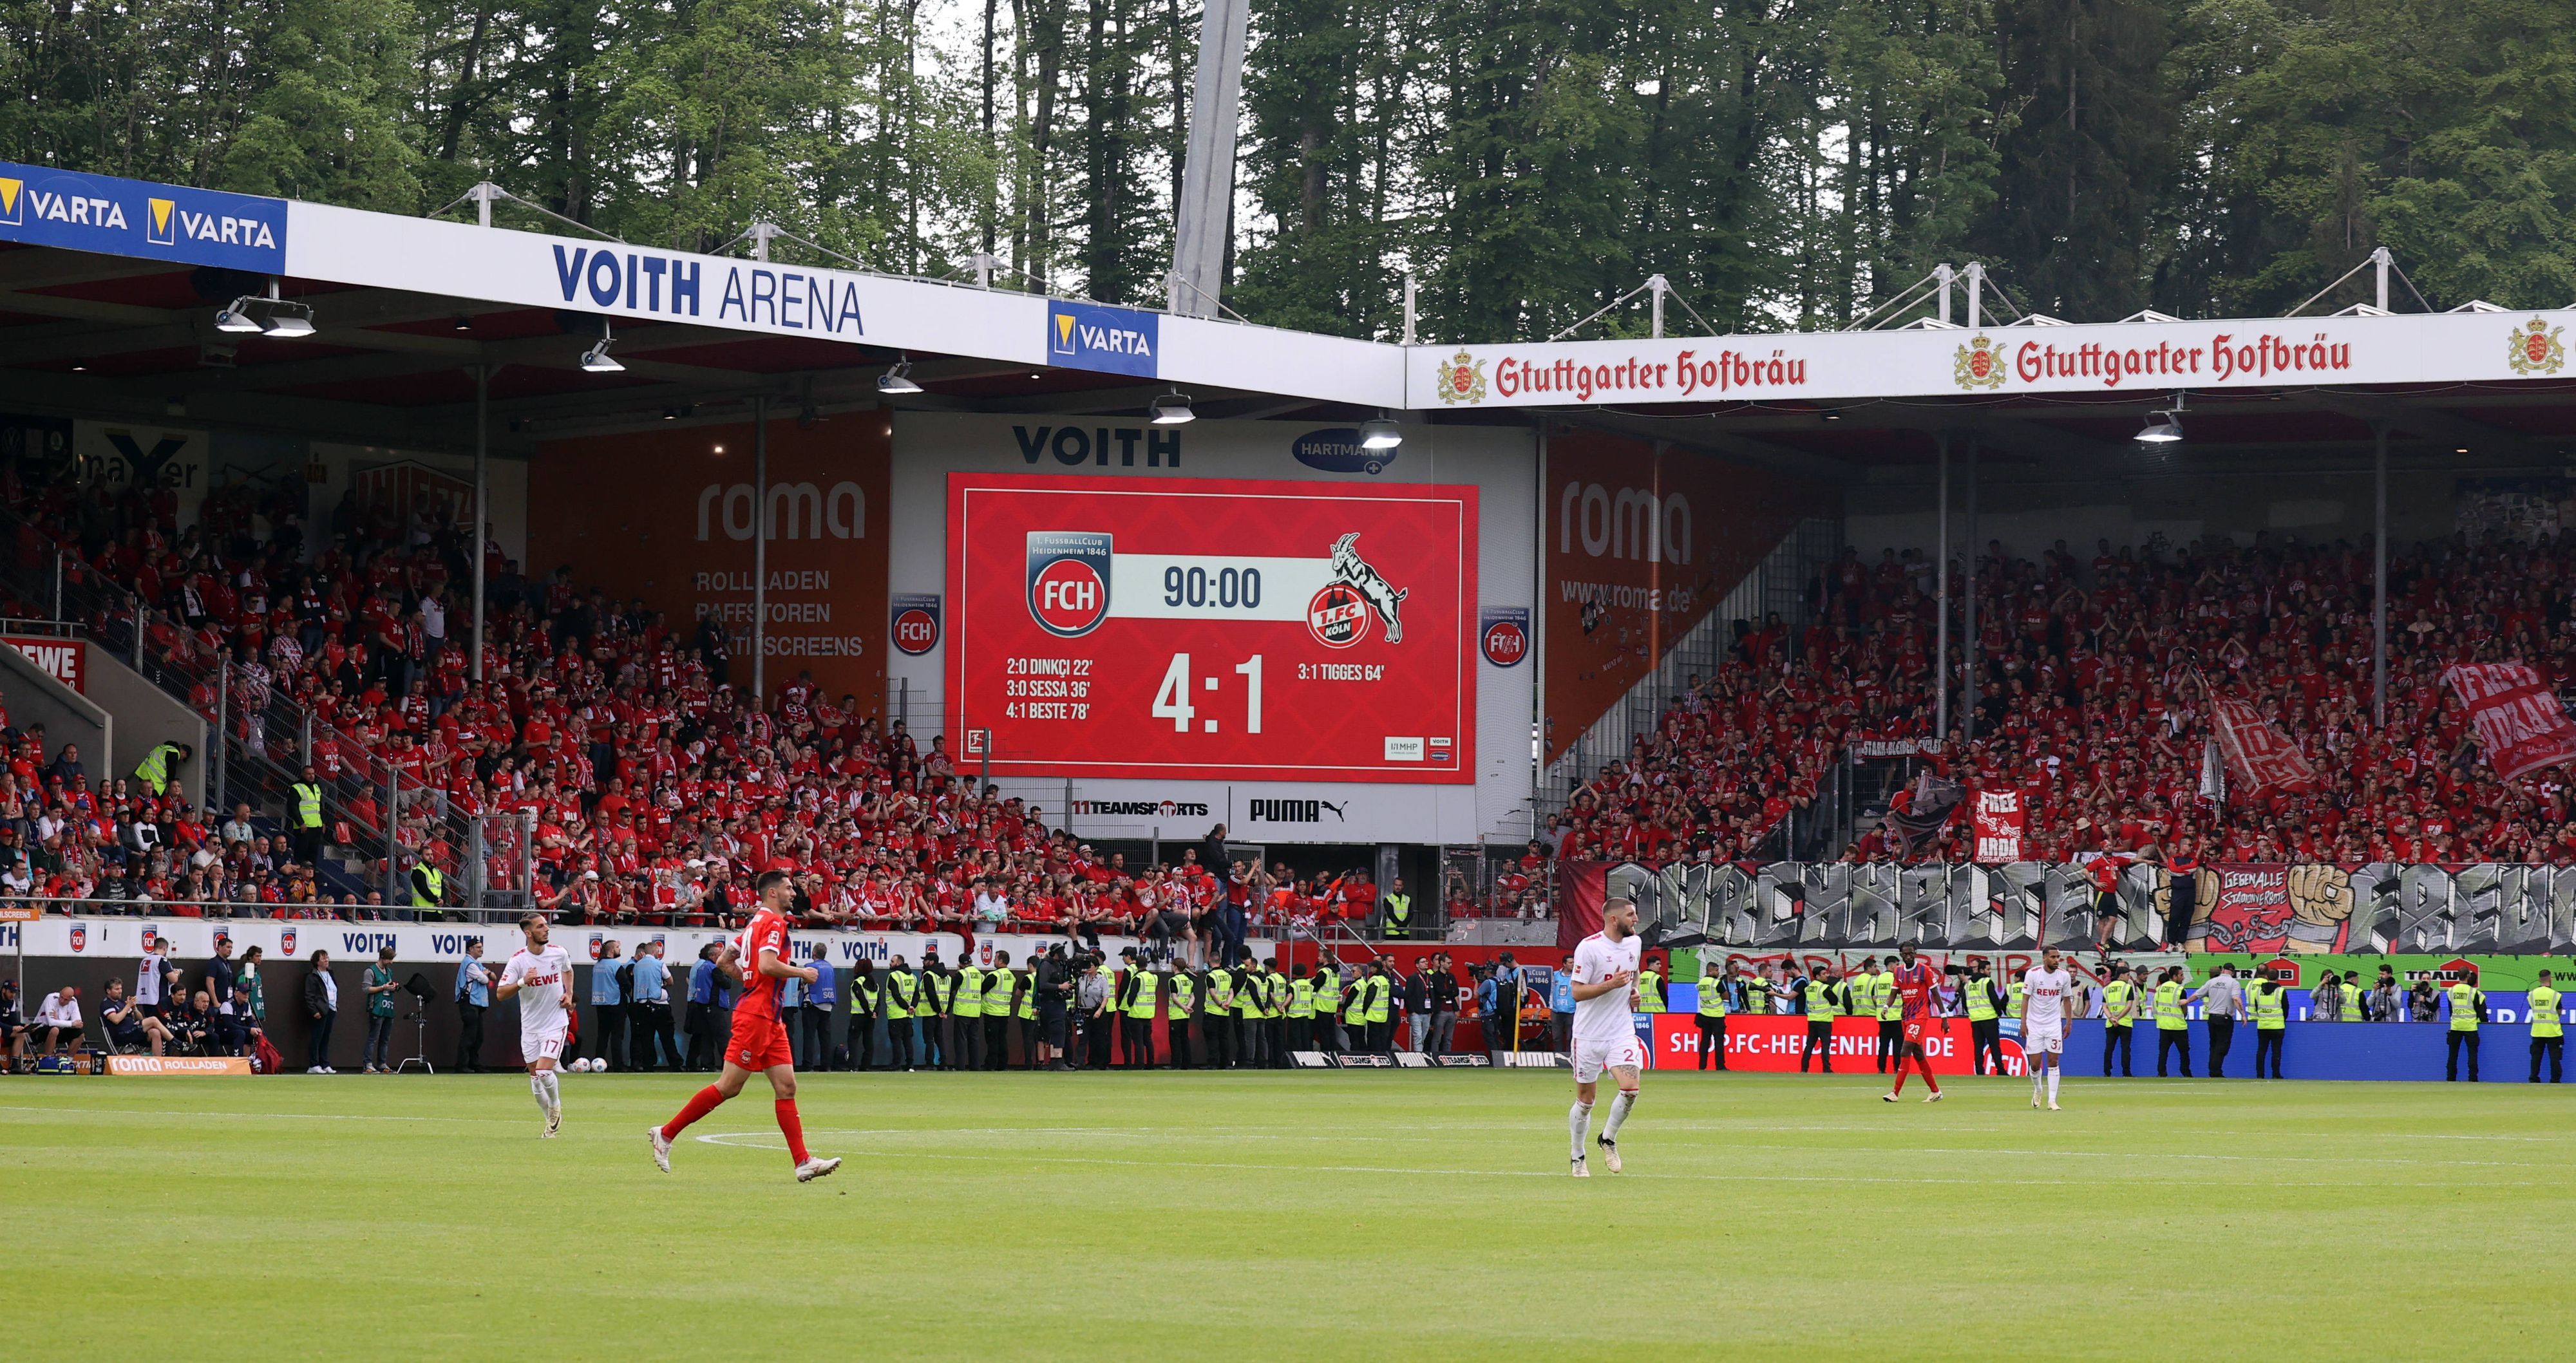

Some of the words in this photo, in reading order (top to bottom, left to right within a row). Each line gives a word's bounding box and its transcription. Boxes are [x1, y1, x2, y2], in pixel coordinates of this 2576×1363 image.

[29, 190, 128, 230] VARTA
[180, 211, 276, 250] VARTA
[553, 245, 700, 316] VOITH
[719, 267, 864, 335] ARENA
[1079, 324, 1151, 357] VARTA
[2016, 341, 2204, 388] Stuttgarter
[2212, 333, 2352, 382] Hofbräu
[1495, 355, 1668, 401] Stuttgarter
[1676, 350, 1808, 396] Hofbräu
[1012, 426, 1180, 467] VOITH
[1302, 443, 1388, 457] HARTMANN
[696, 481, 866, 541] roma
[1560, 481, 1692, 565] roma
[1032, 547, 1084, 555] HEIDENHEIM
[1087, 547, 1107, 556] 1846
[696, 570, 830, 591] ROLLADEN
[1164, 566, 1261, 609] 90:00
[1045, 581, 1095, 610] FCH
[1320, 604, 1356, 625] 1.FC
[900, 623, 931, 641] FCH
[1325, 622, 1351, 637] KÖLN
[9, 644, 76, 678] EWE
[1007, 658, 1027, 675] 2:0
[1030, 659, 1070, 678] DINKÇI
[1073, 659, 1094, 676] 22'
[1298, 663, 1318, 680] 3:1
[1321, 663, 1363, 681] TIGGES
[1365, 664, 1385, 681] 64'
[1007, 681, 1027, 697] 3:0
[1030, 681, 1068, 697] SESSA
[1070, 681, 1091, 698] 36'
[1152, 652, 1263, 734] 4:1
[1006, 702, 1026, 719] 4:1
[1029, 702, 1067, 720] BESTE
[1070, 703, 1090, 720] 78'
[403, 760, 421, 768] REWE
[1251, 799, 1320, 823] PUMA
[1980, 791, 2018, 813] FREE
[1978, 837, 2020, 857] ARDA
[72, 936, 83, 946] FCH
[144, 937, 155, 947] FCH
[283, 941, 294, 949] FCH
[343, 933, 396, 953] VOITH
[842, 941, 887, 960] VOITH
[982, 951, 991, 959] FCH
[526, 973, 559, 988] REWE
[2037, 988, 2060, 997] REWE
[1908, 1024, 1920, 1035] 23
[545, 1039, 560, 1054] 17
[111, 1058, 162, 1072] roma
[165, 1060, 227, 1070] ROLLLADEN
[1293, 1051, 1324, 1066] PUMA
[1395, 1051, 1426, 1067] PUMA
[1504, 1051, 1555, 1067] PUMA
